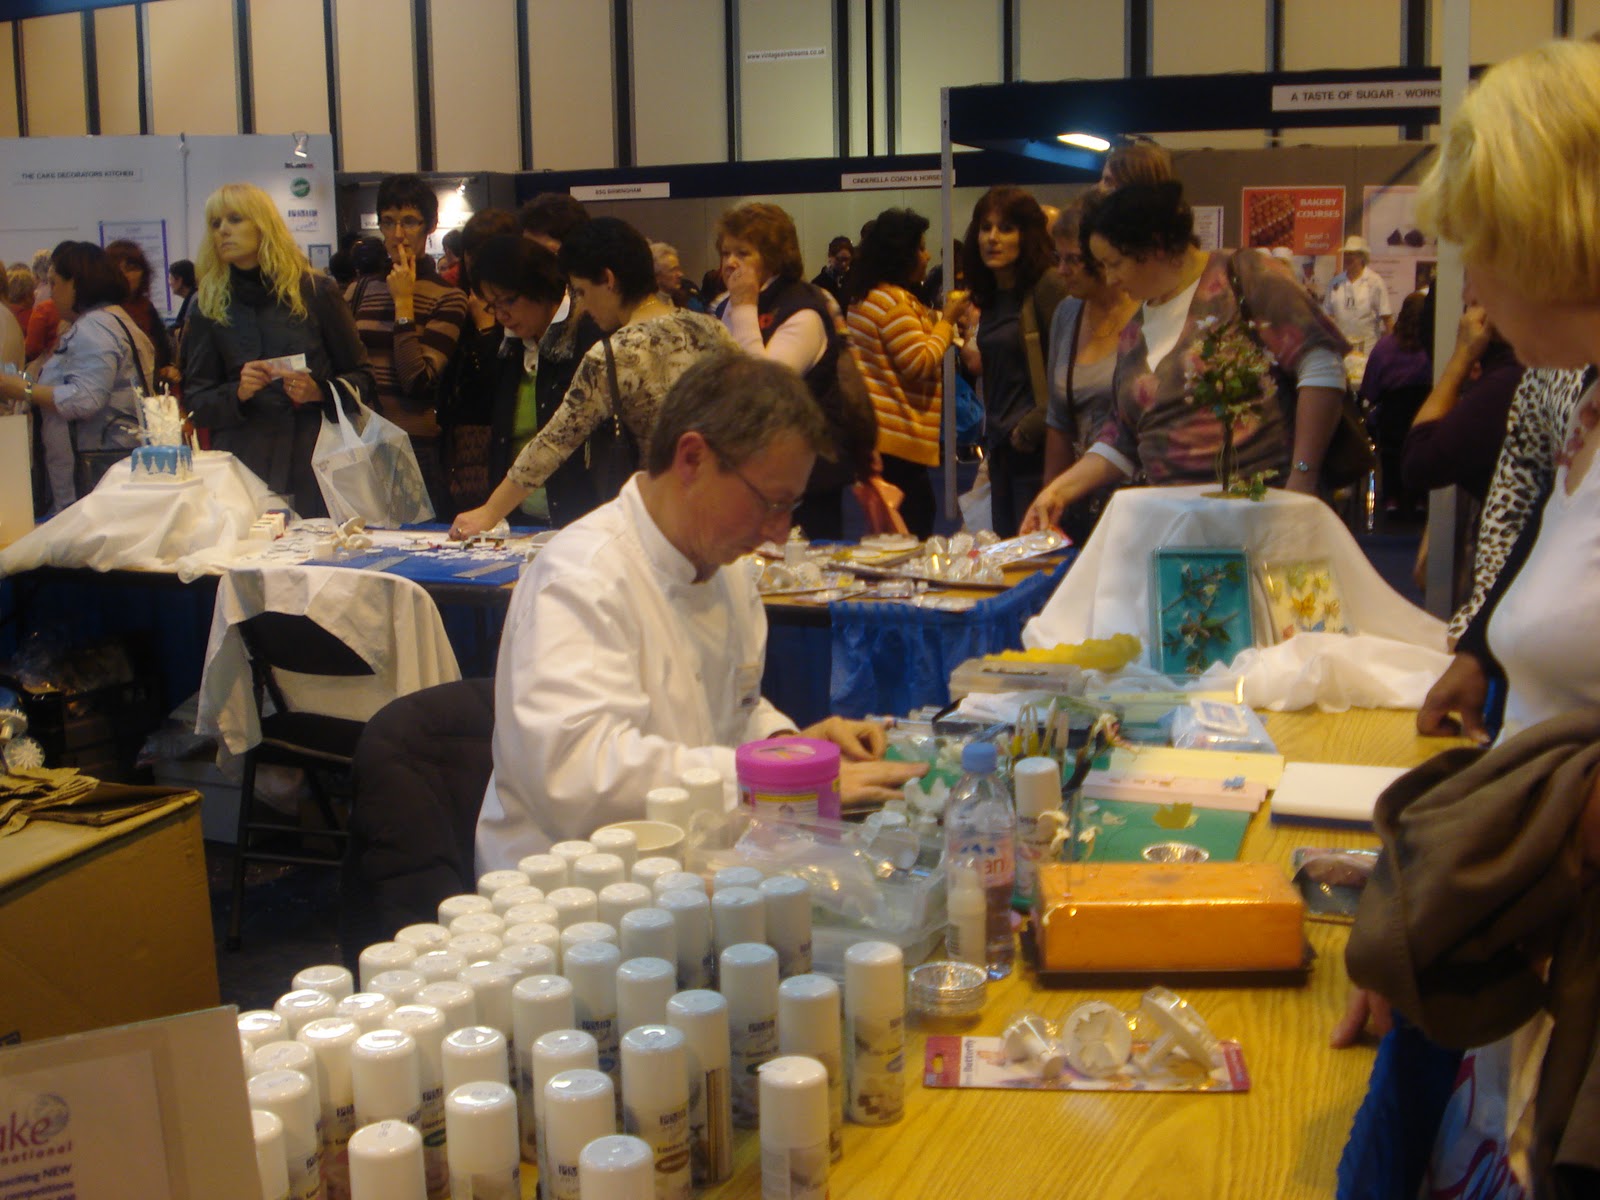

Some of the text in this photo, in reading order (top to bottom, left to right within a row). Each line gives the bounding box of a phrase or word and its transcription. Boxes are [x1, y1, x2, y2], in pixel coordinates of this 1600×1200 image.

[1291, 92, 1298, 101] A
[1303, 91, 1334, 101] TASTE
[1338, 90, 1352, 99] OF
[1356, 89, 1394, 99] SUGAR
[104, 169, 135, 177] KITCHEN
[852, 176, 889, 184] CINDERELLA
[890, 175, 913, 183] COACH
[1300, 198, 1337, 206] BAKERY
[1296, 210, 1340, 218] COURSES
[43, 1163, 72, 1177] NEW
